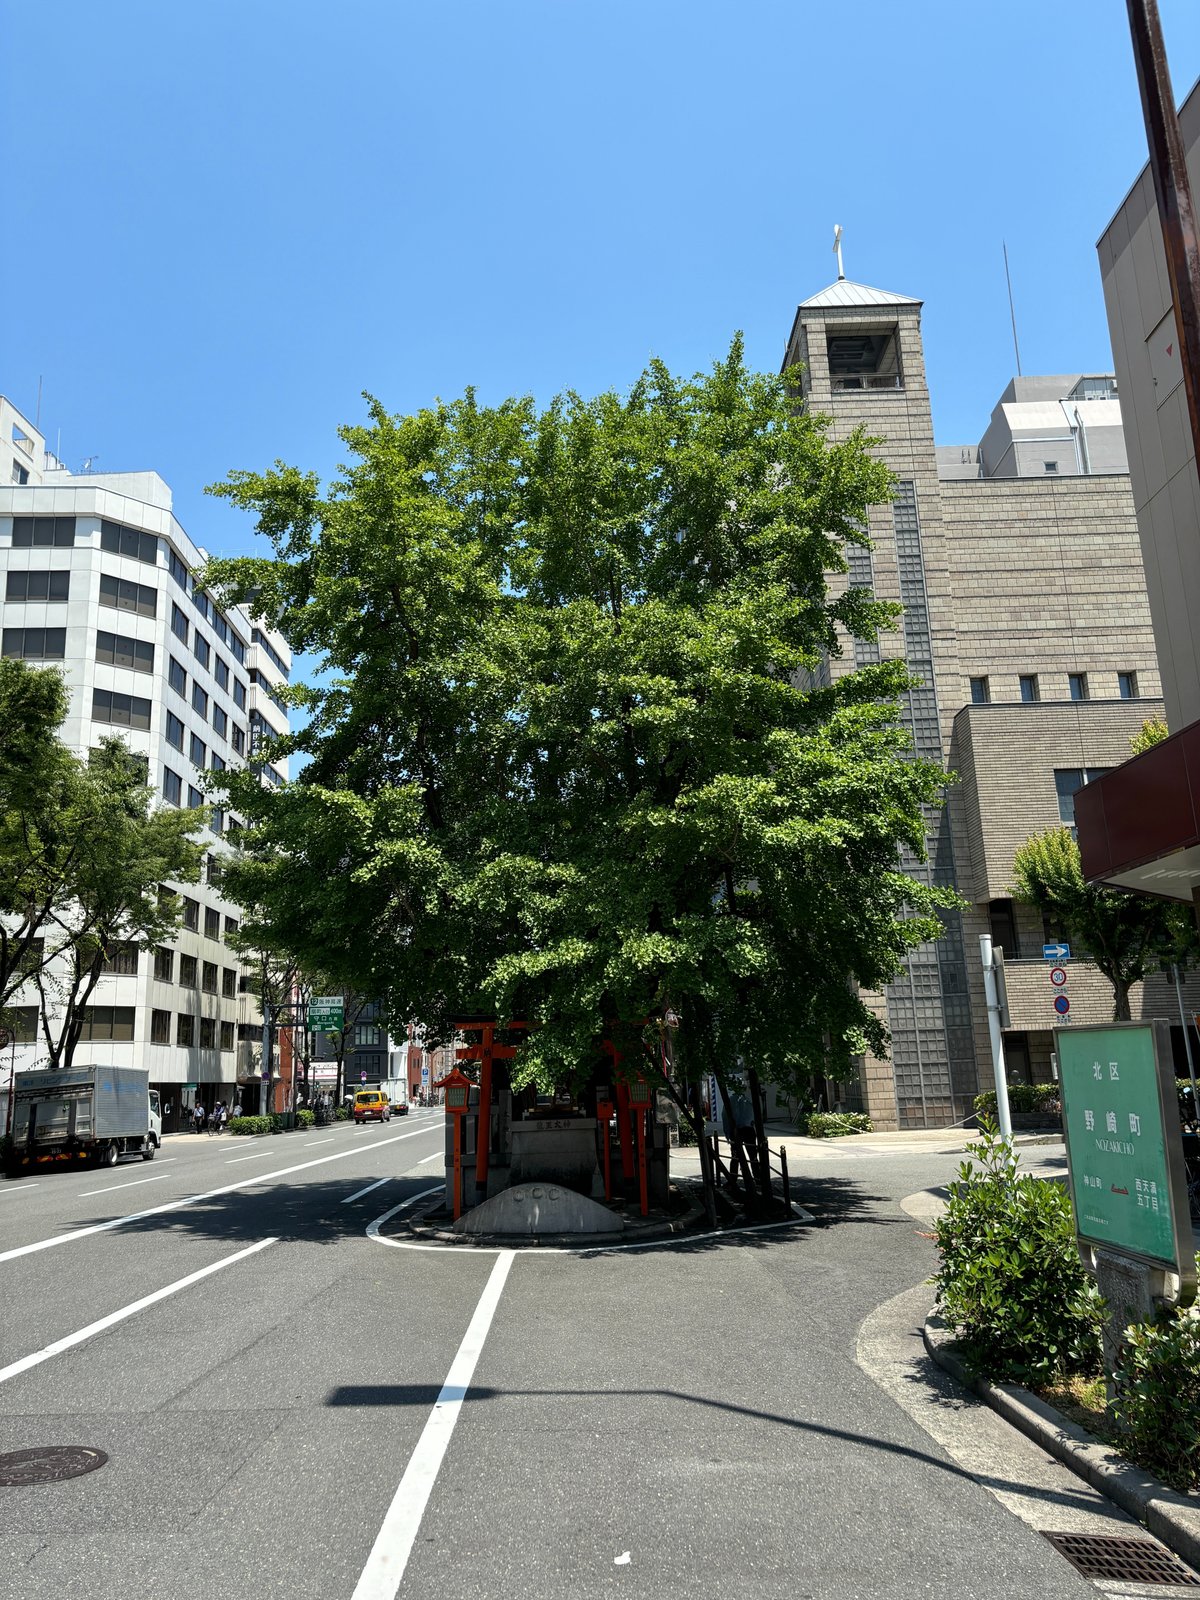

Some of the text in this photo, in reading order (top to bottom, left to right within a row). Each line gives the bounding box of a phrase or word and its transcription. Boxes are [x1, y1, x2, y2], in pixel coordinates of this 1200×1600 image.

[1054, 972, 1063, 982] 30
[1092, 1061, 1120, 1081] 北区
[1084, 1109, 1141, 1137] 野崎町
[1095, 1138, 1135, 1156] NOZAKICHO
[1083, 1174, 1158, 1194] 神山町 西天満
[1136, 1194, 1158, 1211] 五丁目
